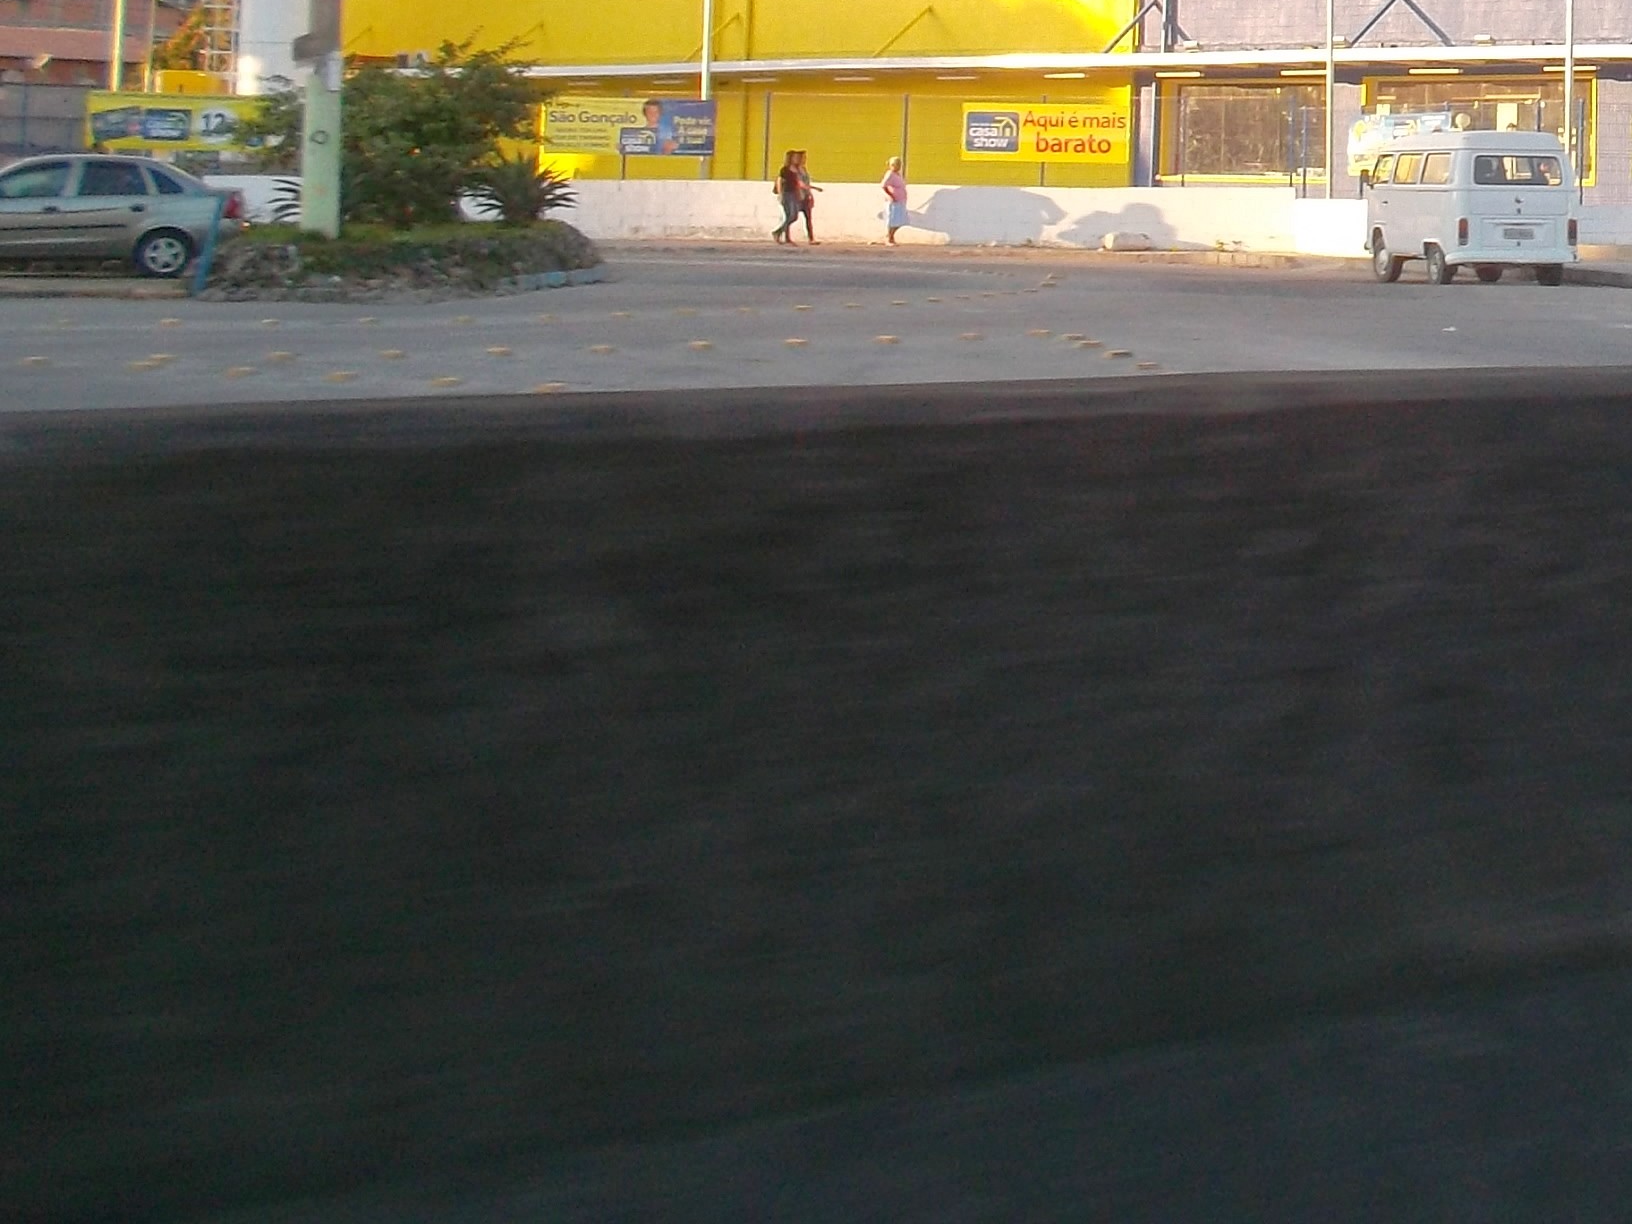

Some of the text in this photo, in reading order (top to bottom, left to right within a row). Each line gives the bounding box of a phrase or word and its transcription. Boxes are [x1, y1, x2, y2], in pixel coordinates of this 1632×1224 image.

[550, 111, 638, 126] São Gonçalo
[1023, 111, 1126, 131] Aqui é mais
[968, 127, 999, 137] casa
[973, 136, 1009, 148] show
[1036, 133, 1112, 154] barato
